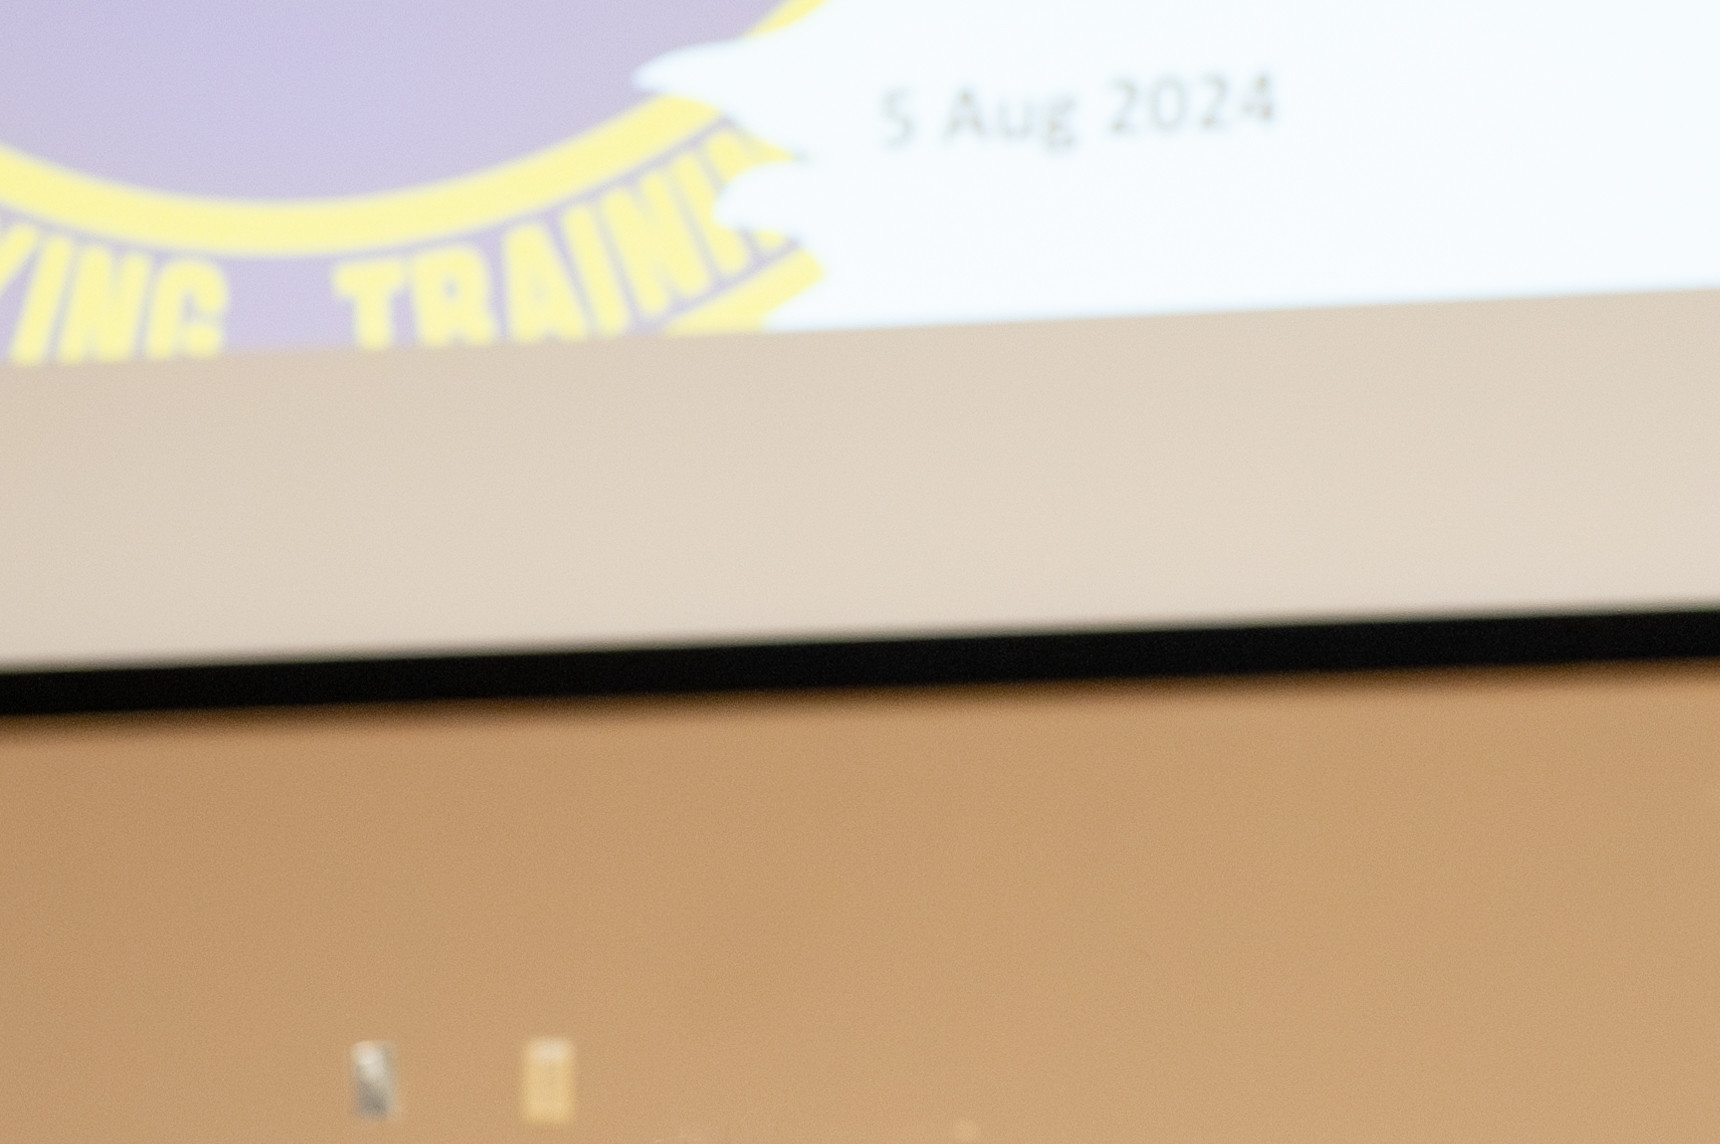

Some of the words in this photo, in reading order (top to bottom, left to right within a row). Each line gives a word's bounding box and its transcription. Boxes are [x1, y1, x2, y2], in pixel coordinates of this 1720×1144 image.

[882, 88, 916, 148] 5
[943, 91, 1077, 153] Aug
[1109, 72, 1273, 134] 2024
